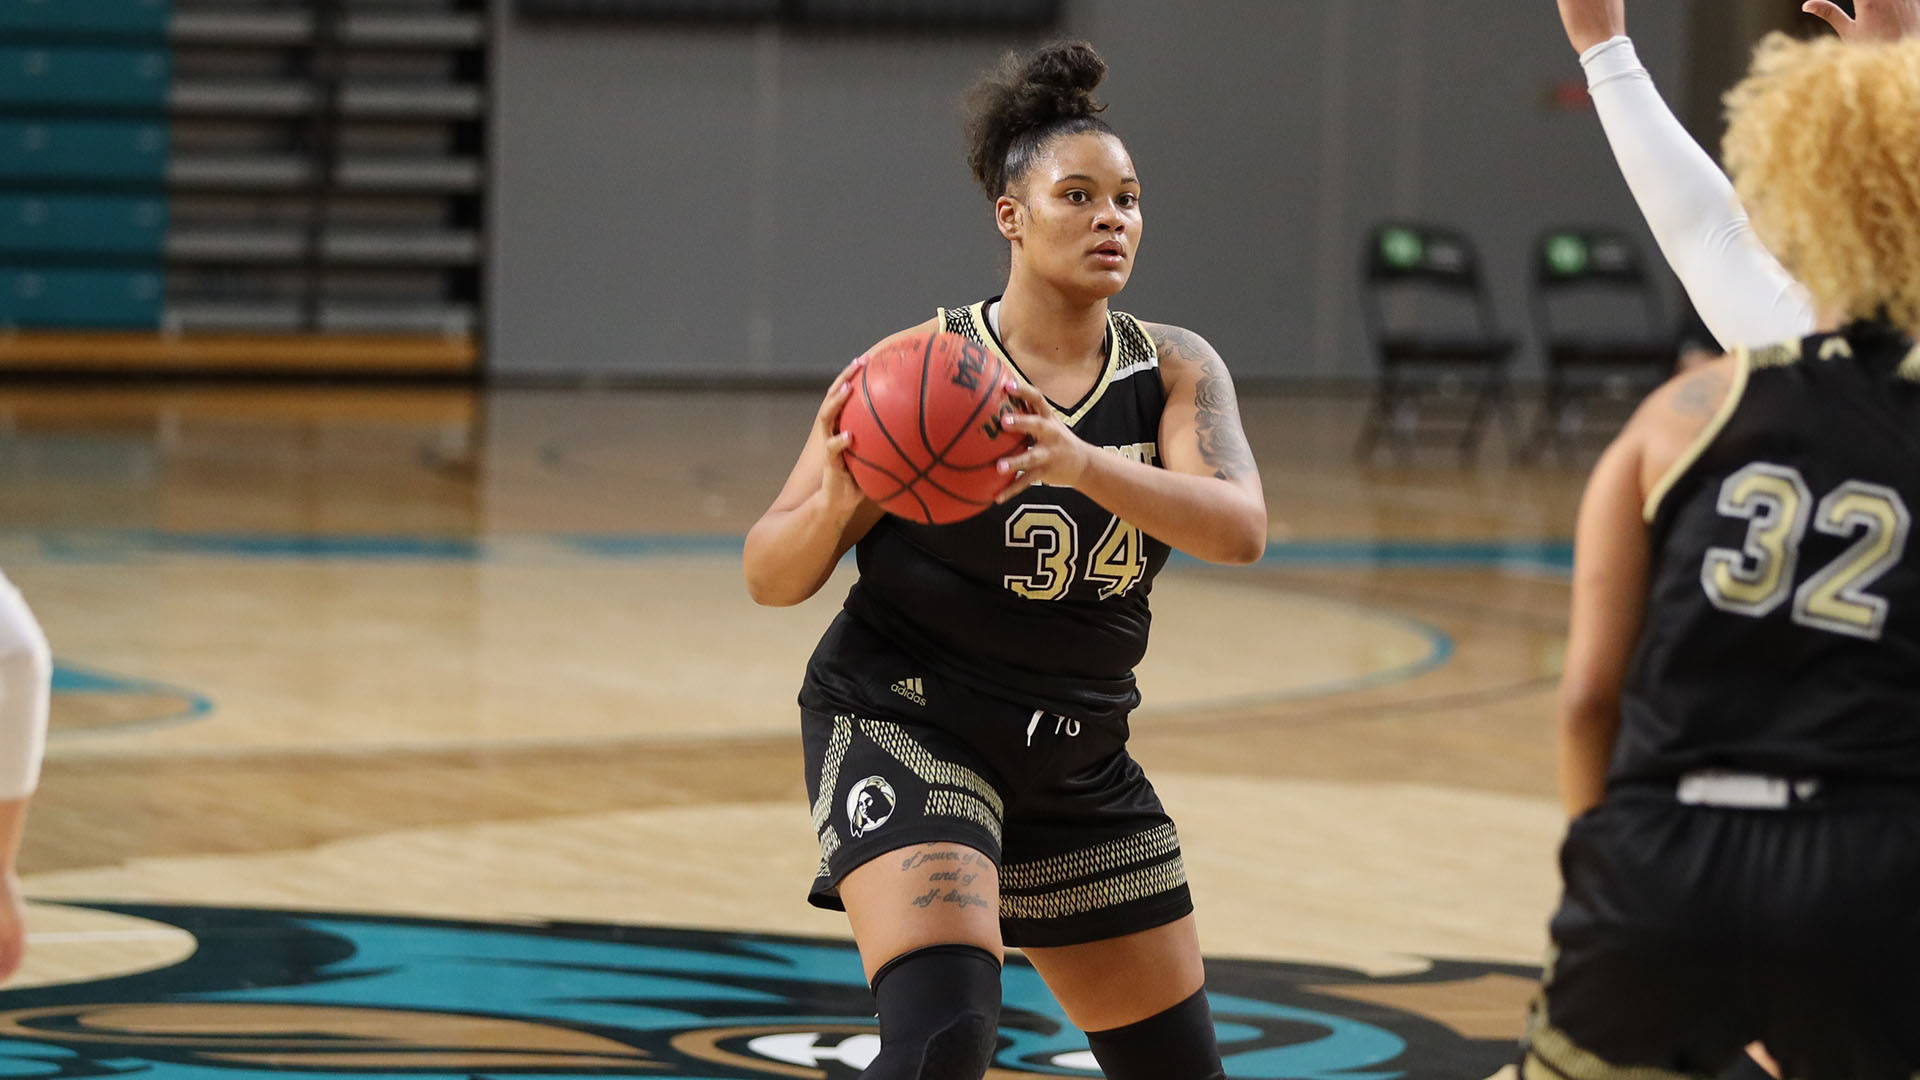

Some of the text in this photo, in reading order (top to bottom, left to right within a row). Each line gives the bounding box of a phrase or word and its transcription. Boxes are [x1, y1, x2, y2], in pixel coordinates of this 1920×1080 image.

[1004, 503, 1147, 601] 34
[1701, 461, 1911, 641] 32
[891, 683, 927, 706] adidas
[929, 868, 962, 882] and
